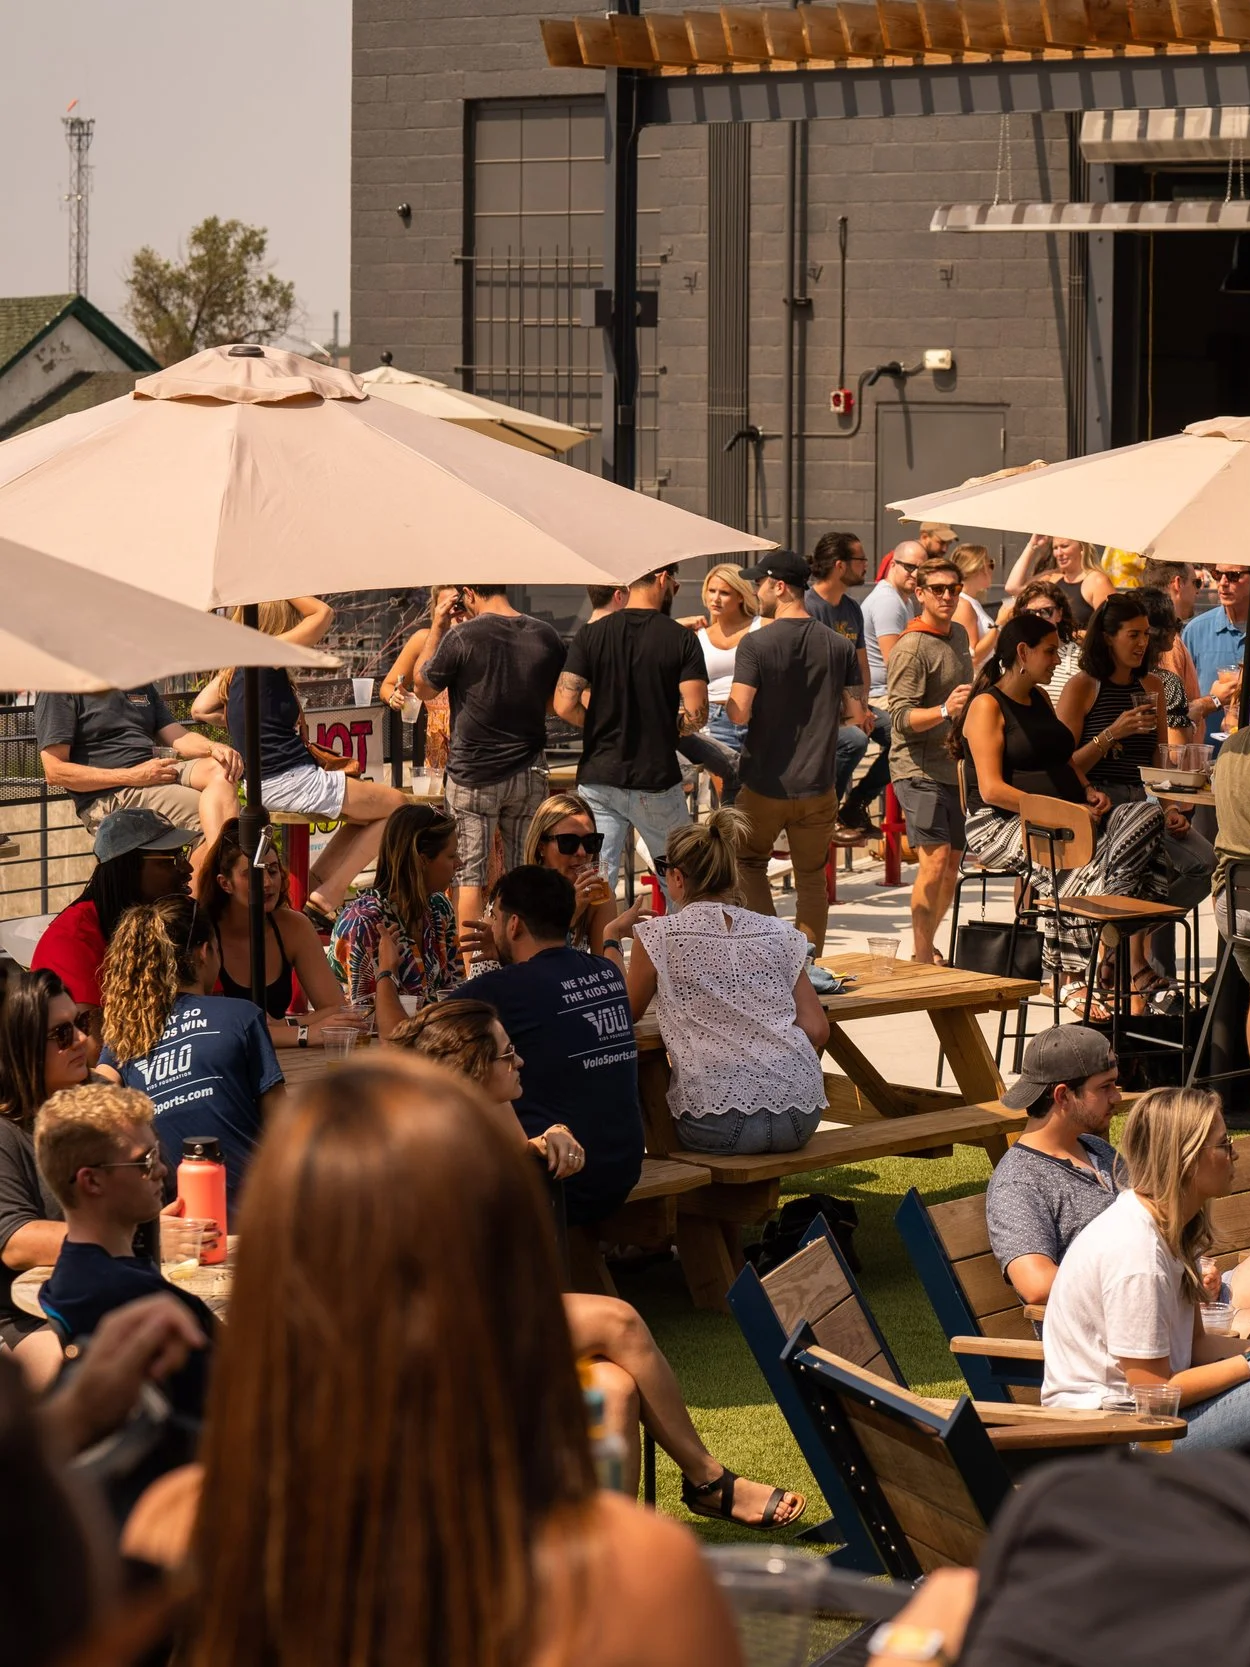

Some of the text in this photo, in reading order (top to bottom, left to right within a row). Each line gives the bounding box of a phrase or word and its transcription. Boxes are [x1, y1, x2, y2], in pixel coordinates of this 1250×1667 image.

[560, 969, 614, 990] WE PLAY SO
[562, 981, 624, 1004] THE KIDS WIN
[182, 1008, 201, 1019] SO
[582, 1004, 628, 1036] VOLO
[180, 1019, 207, 1033] WIN
[134, 1043, 192, 1086] VOLO
[158, 1071, 192, 1086] FOUNDATION
